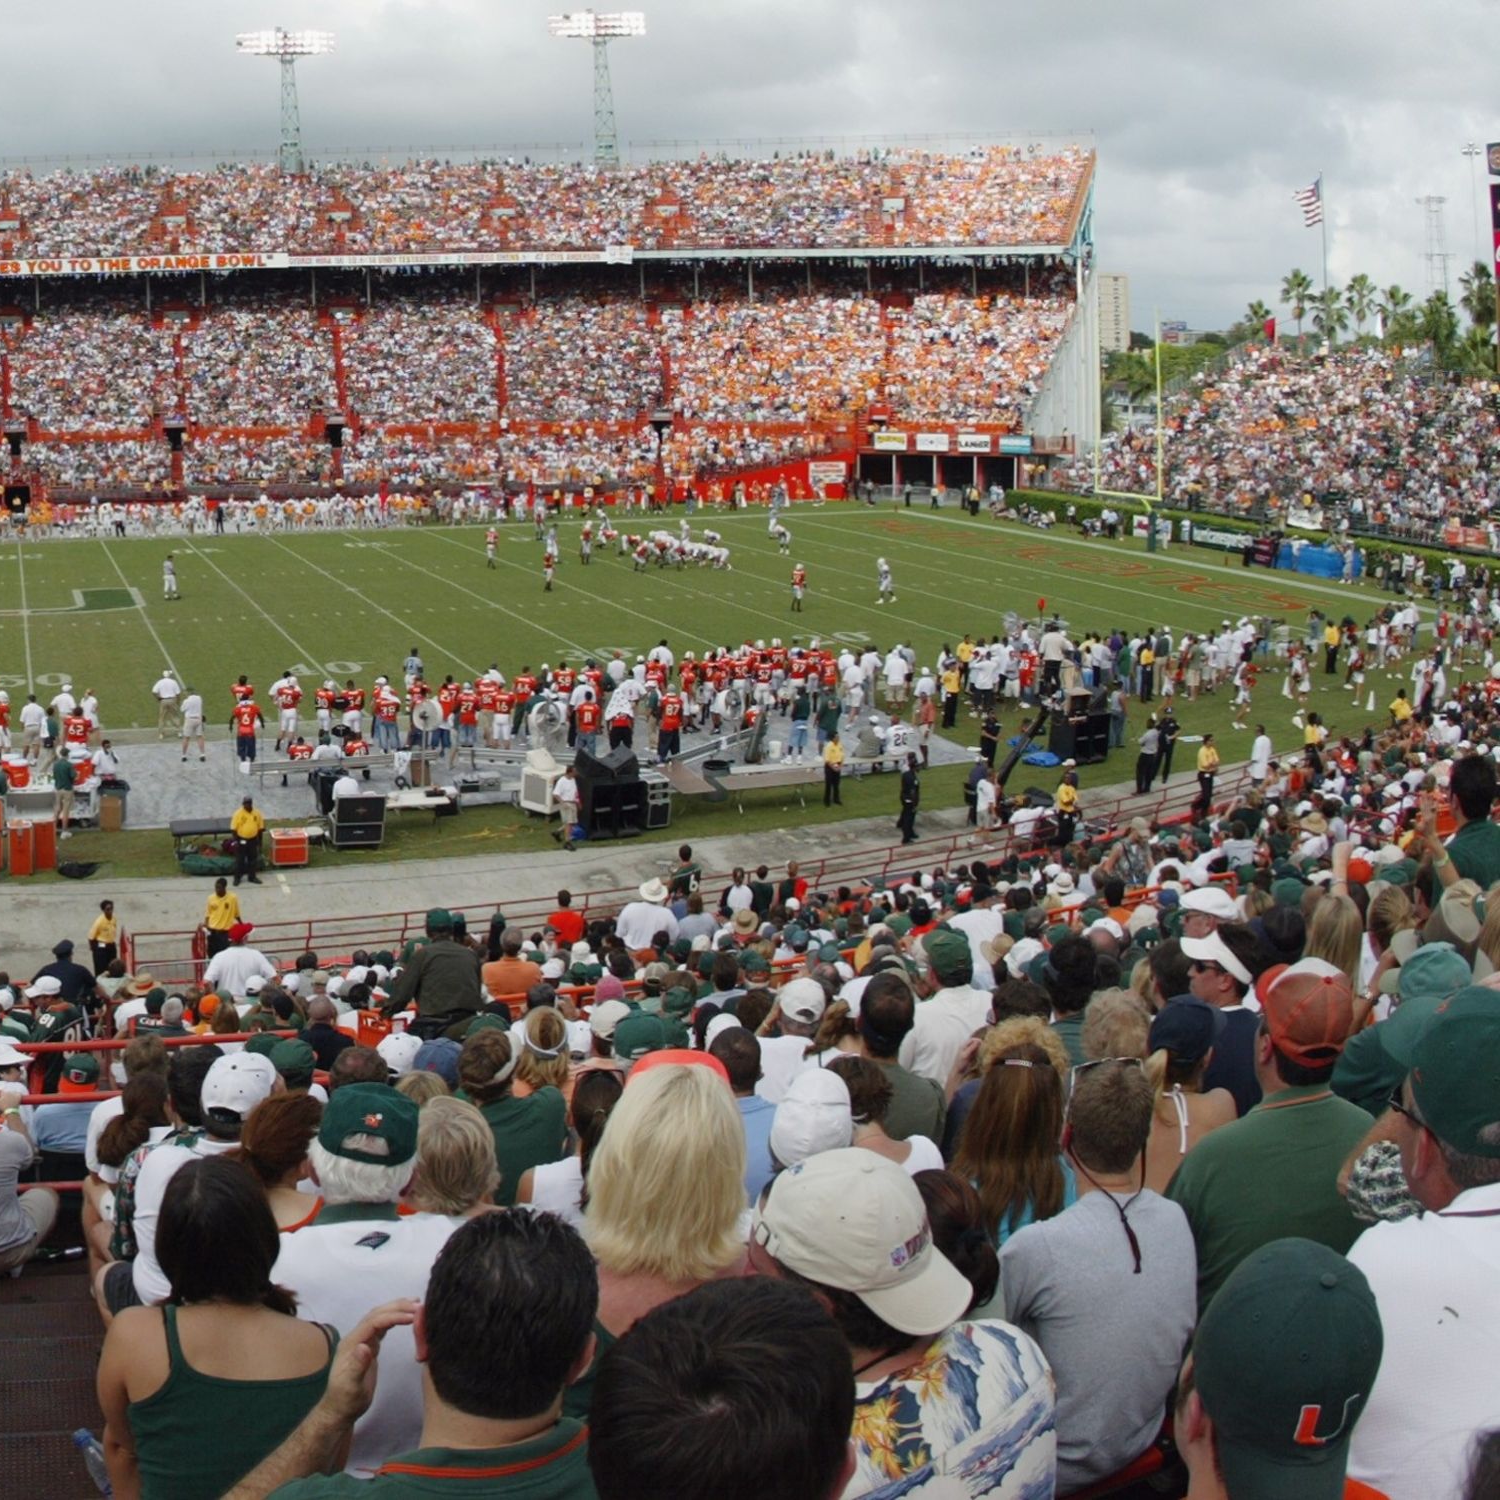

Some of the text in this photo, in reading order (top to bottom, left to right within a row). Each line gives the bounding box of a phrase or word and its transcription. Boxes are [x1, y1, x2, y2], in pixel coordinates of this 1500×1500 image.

[28, 260, 62, 273] YOU
[69, 259, 92, 272] TO
[97, 258, 131, 271] THE
[137, 255, 211, 270] ORANGE
[286, 661, 364, 676] 40
[460, 701, 473, 712] 27
[496, 701, 508, 712] 16
[665, 704, 680, 716] 87
[242, 714, 250, 725] 6
[68, 724, 84, 736] 62
[689, 873, 699, 892] 6
[38, 1013, 56, 1029] 81
